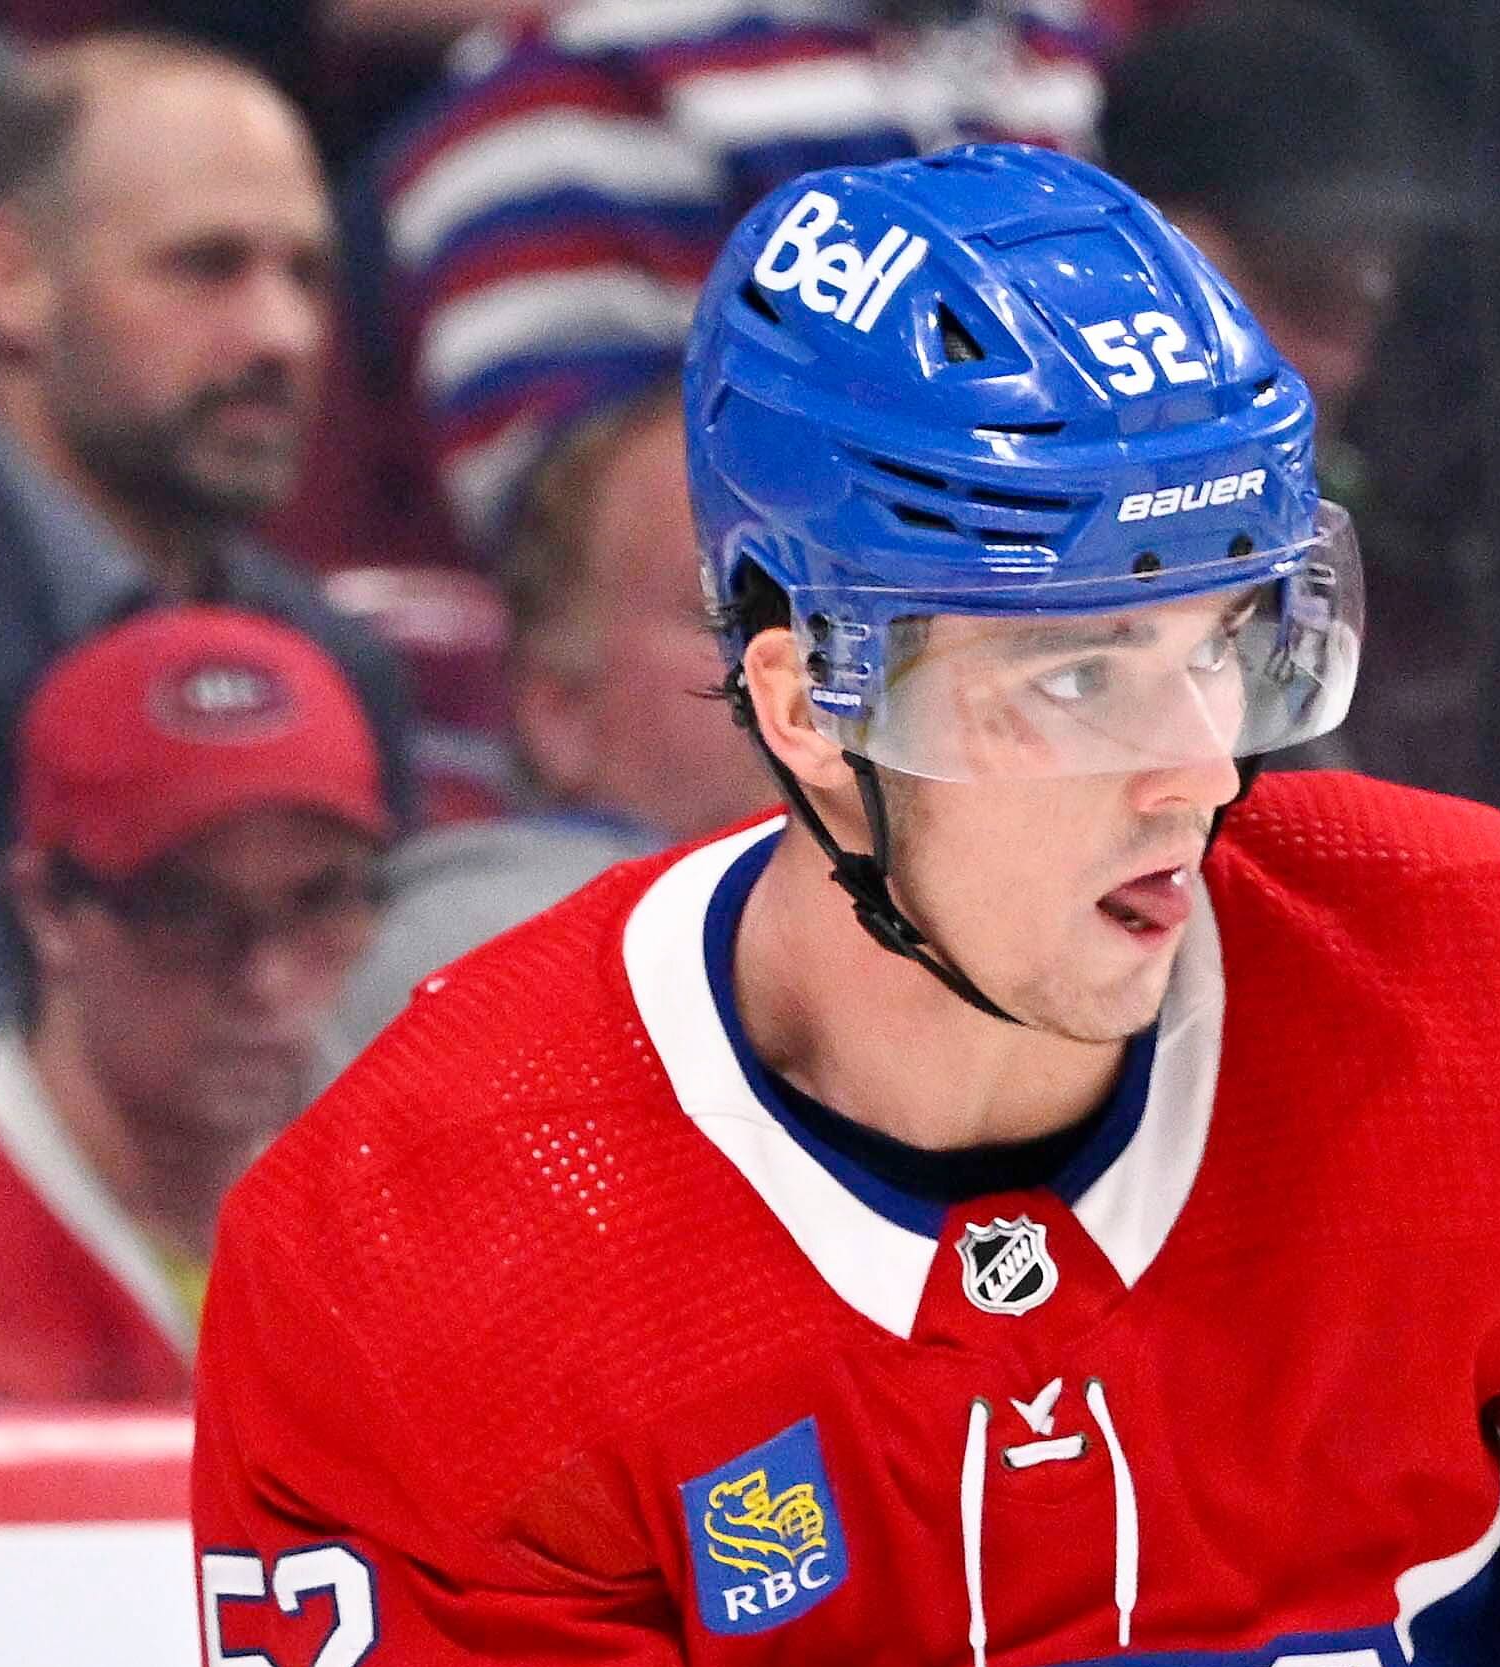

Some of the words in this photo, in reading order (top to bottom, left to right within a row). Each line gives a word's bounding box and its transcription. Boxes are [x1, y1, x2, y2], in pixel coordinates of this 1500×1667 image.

[753, 189, 929, 332] Bell
[1079, 310, 1207, 396] 52
[1117, 468, 1268, 523] BAUER
[723, 1552, 832, 1623] RBC
